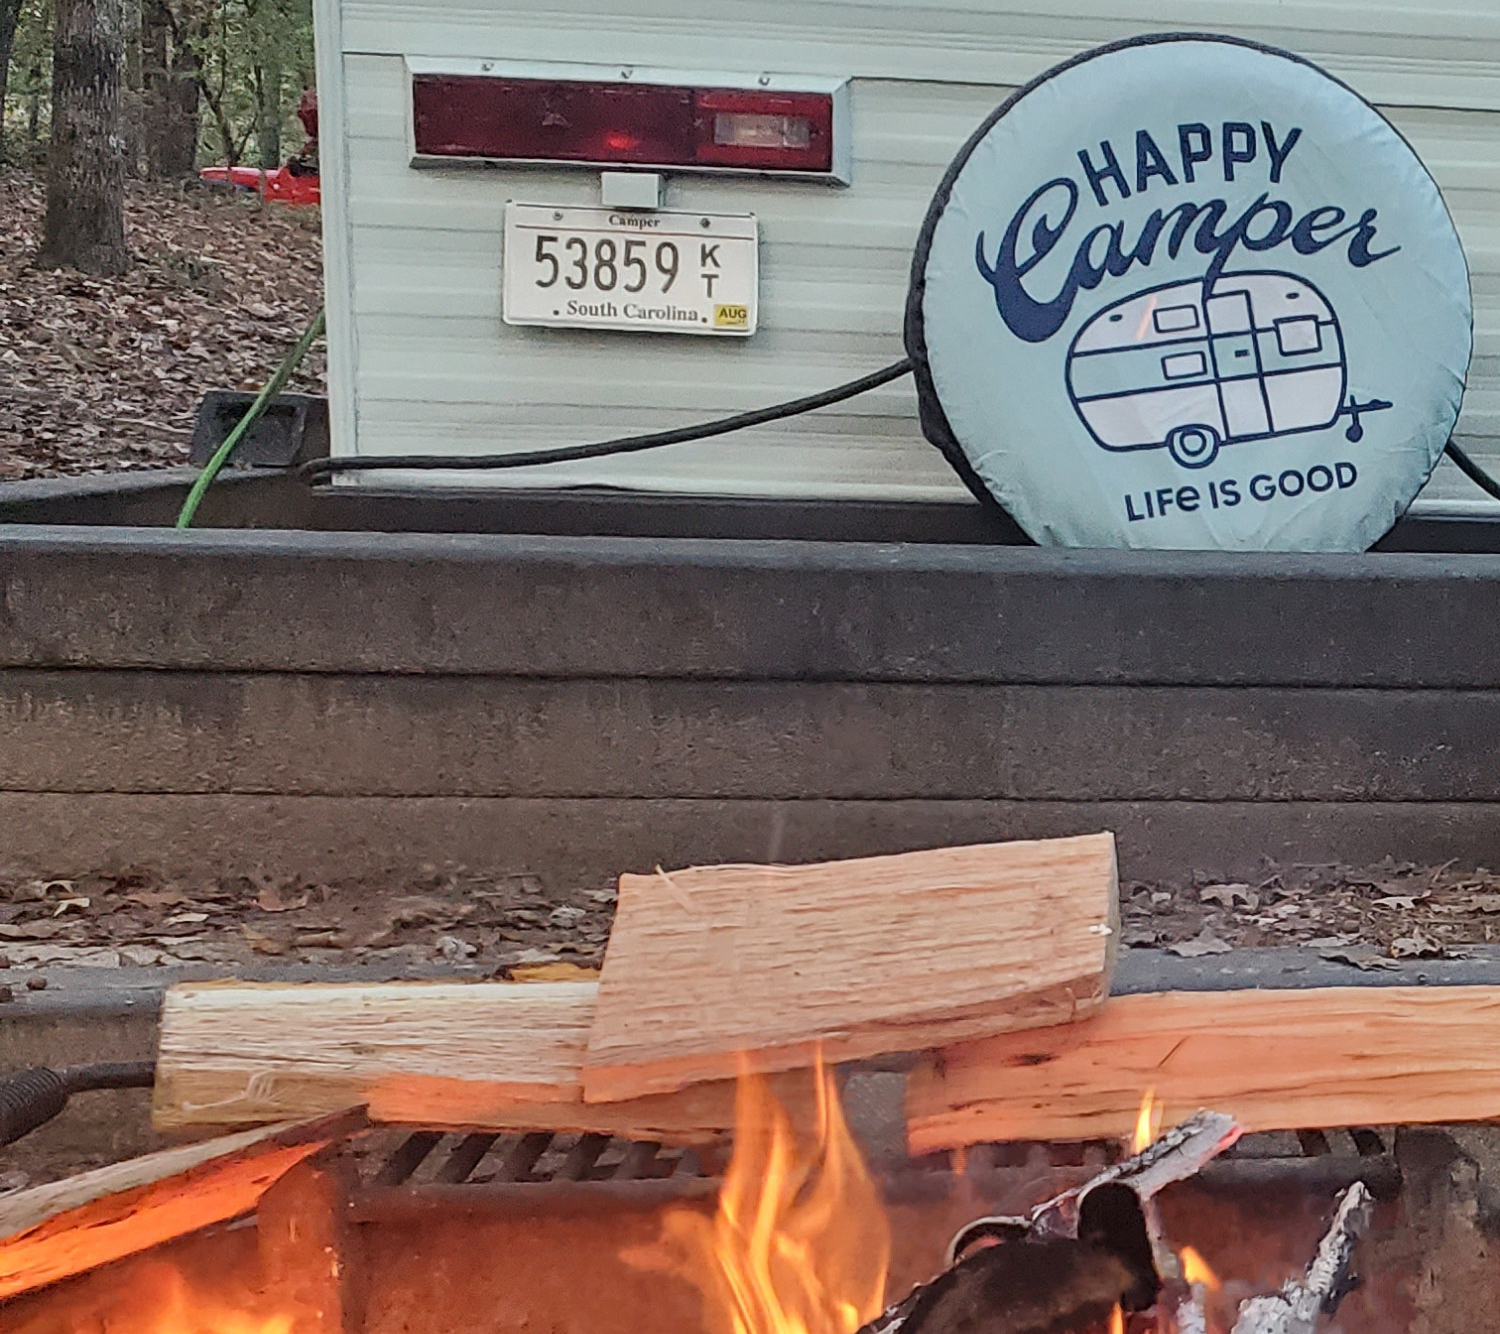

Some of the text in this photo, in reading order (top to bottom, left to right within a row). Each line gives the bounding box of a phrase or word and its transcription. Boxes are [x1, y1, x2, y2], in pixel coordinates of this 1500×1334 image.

[1078, 121, 1302, 206] HAPPY
[608, 214, 660, 229] Camper
[535, 235, 679, 294] 53859
[976, 177, 1402, 343] Camper
[567, 300, 698, 322] South Carolina
[719, 307, 747, 319] AUG
[1209, 480, 1241, 510] IS
[1250, 462, 1357, 501] GOOD
